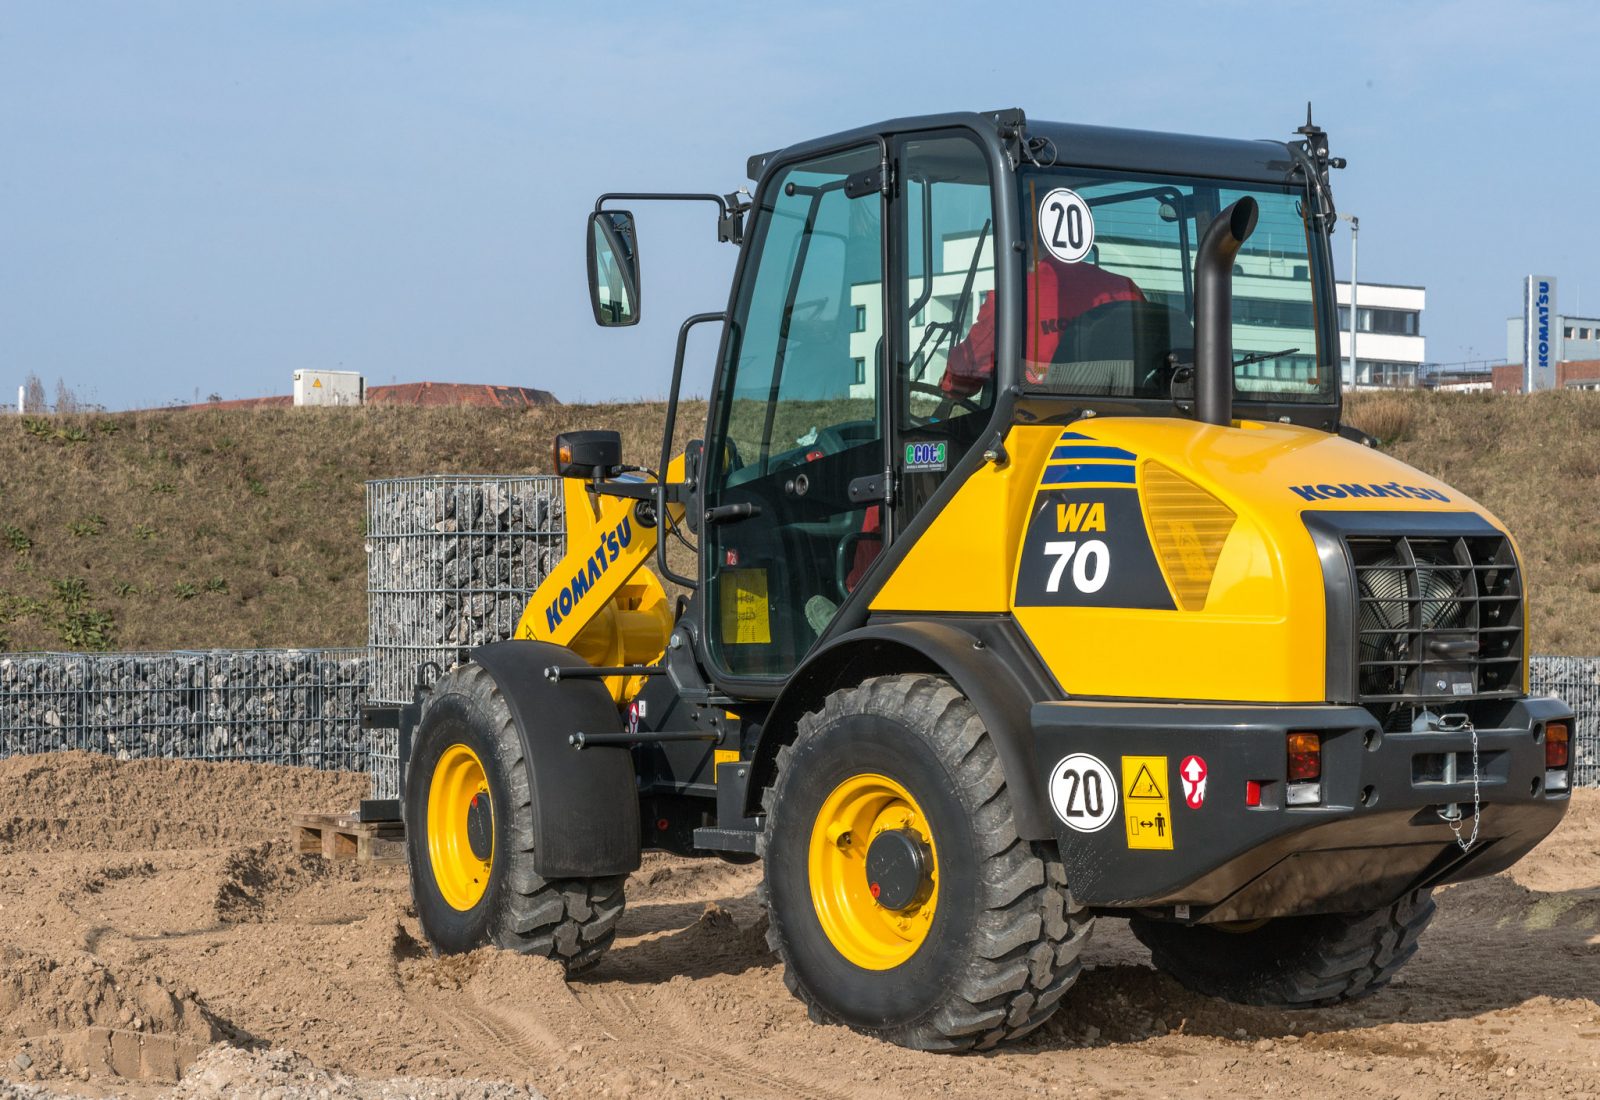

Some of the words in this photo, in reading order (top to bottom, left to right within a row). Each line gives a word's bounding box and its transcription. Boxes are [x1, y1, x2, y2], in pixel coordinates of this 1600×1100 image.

[1050, 202, 1083, 249] 20
[1536, 282, 1549, 367] KOMATSU
[1288, 481, 1451, 503] KOMATSU
[1056, 502, 1106, 533] WA
[545, 515, 632, 634] KOMATSU
[1043, 540, 1110, 593] 70
[1063, 769, 1104, 818] 20
